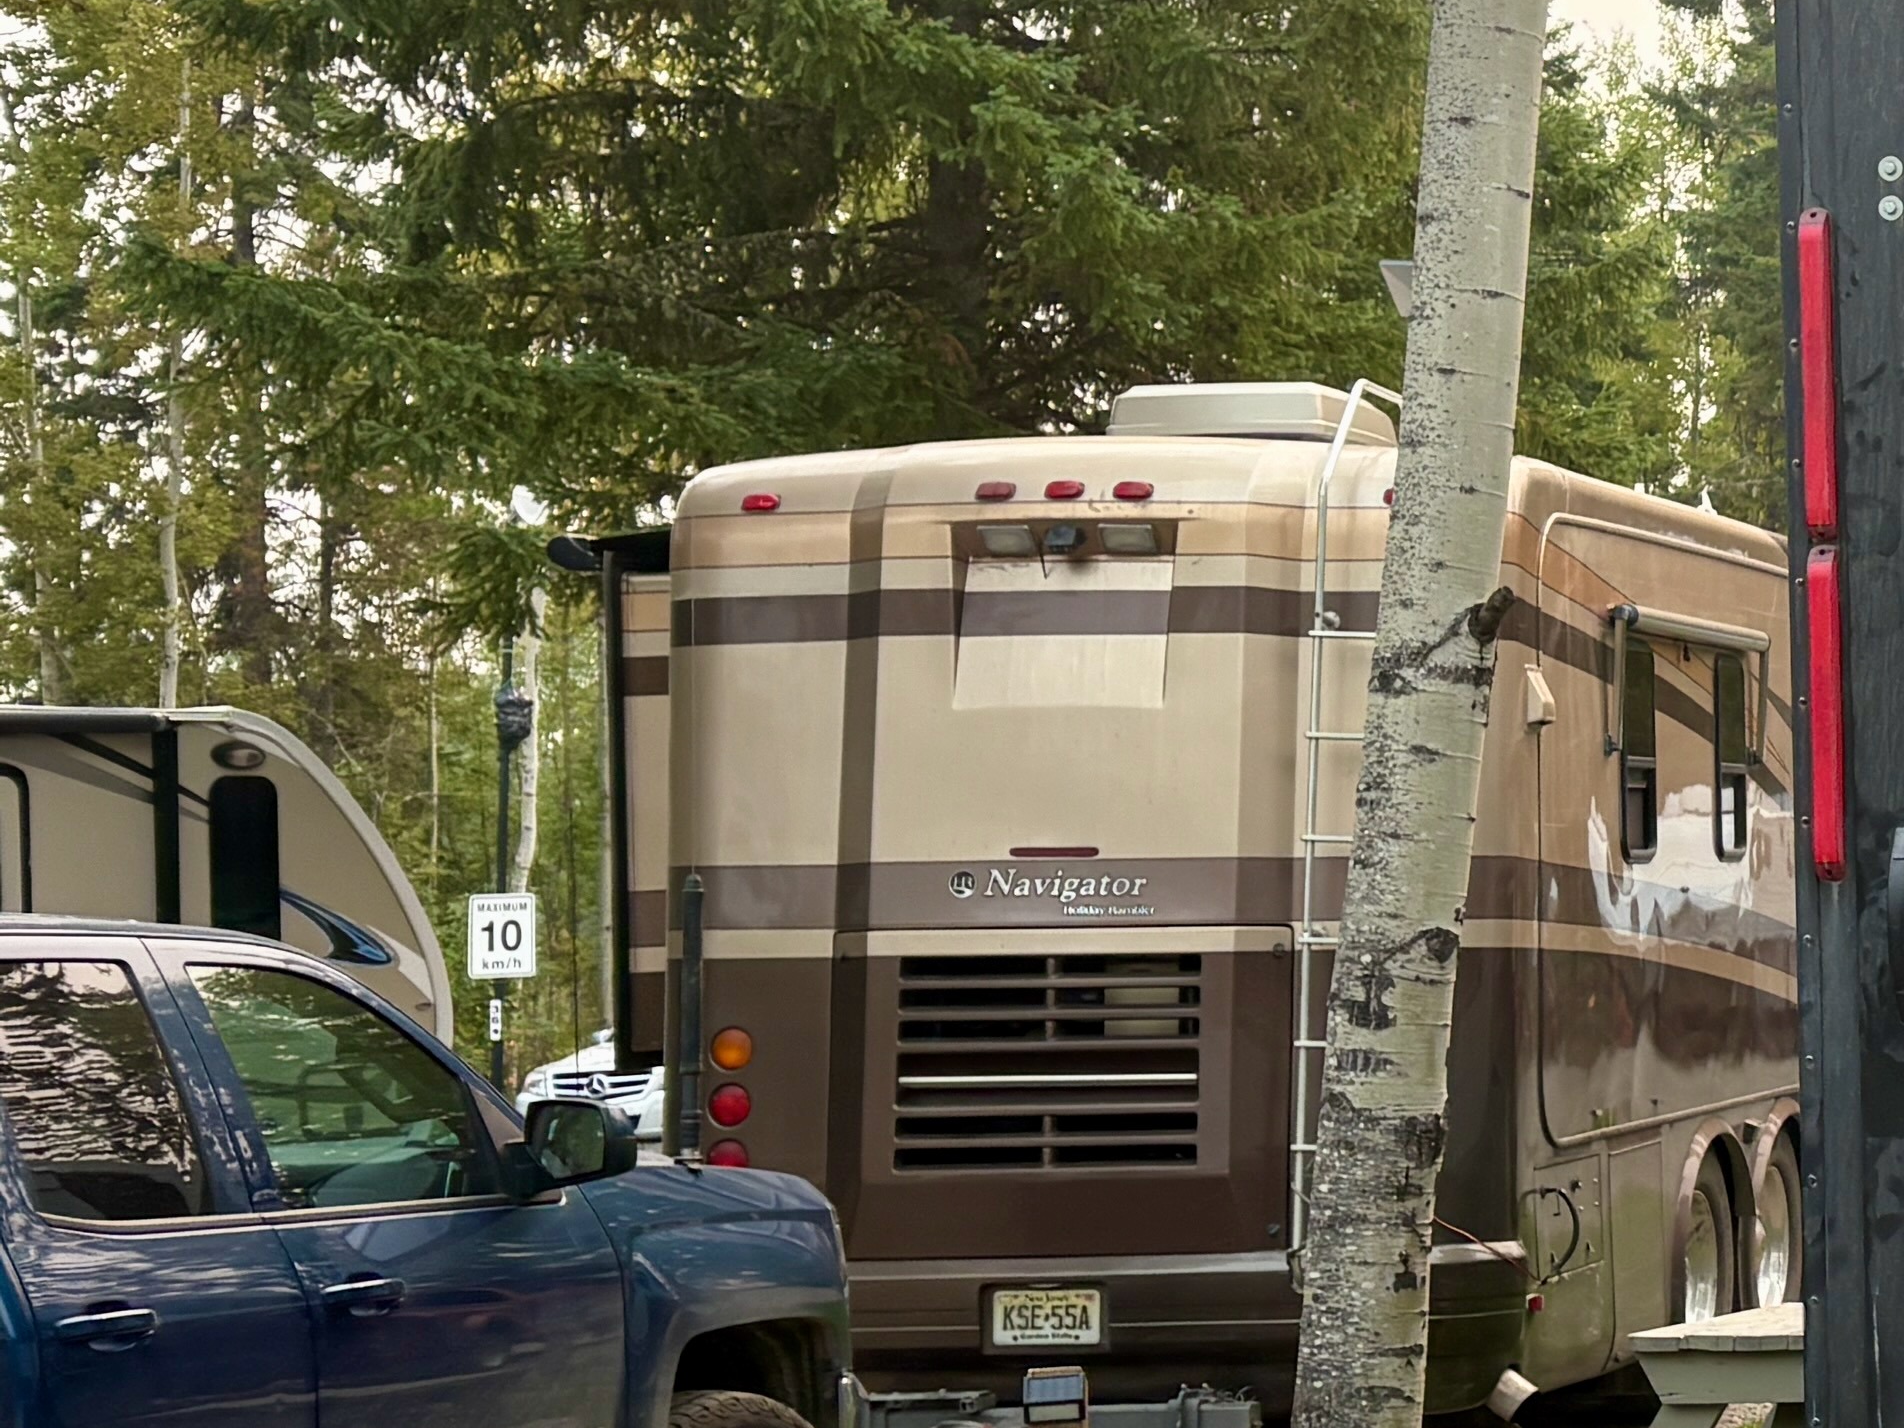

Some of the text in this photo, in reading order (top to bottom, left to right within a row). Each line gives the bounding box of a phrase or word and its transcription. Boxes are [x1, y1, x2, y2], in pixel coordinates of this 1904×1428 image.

[984, 869, 1147, 902] Navigator
[477, 902, 527, 912] MAXIMUM
[481, 920, 522, 952] 10
[482, 957, 522, 970] km/h
